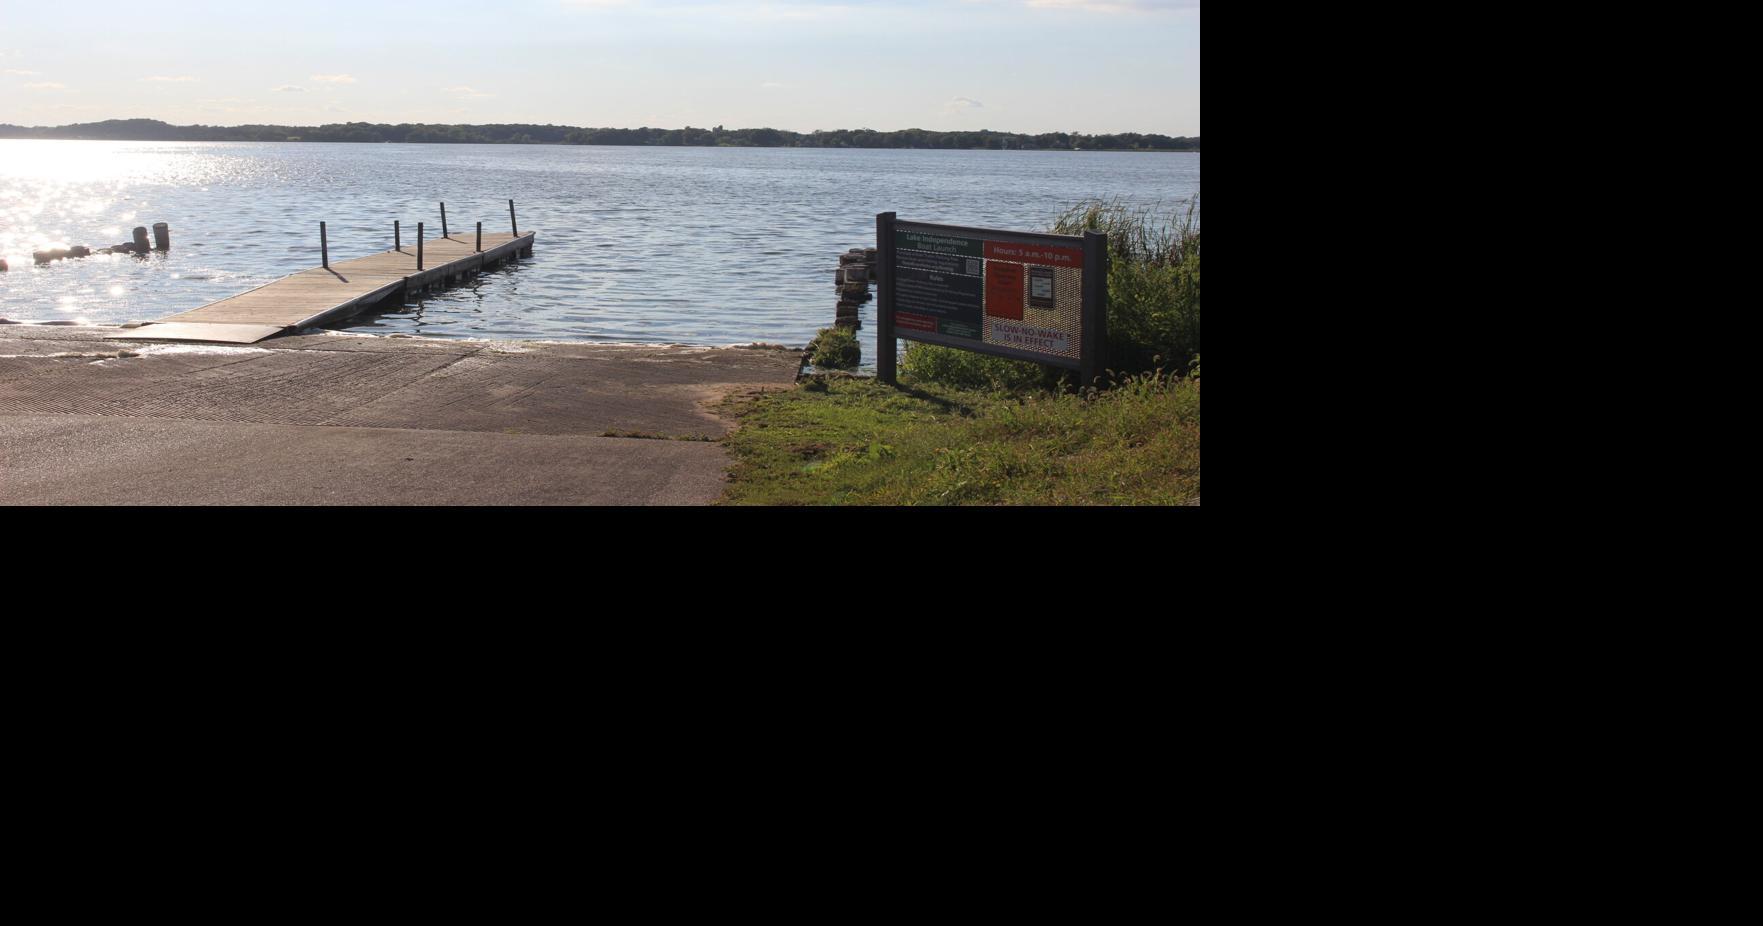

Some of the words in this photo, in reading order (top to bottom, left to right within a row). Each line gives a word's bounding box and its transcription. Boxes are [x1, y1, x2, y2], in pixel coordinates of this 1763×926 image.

[906, 233, 920, 242] Lake
[922, 235, 969, 247] Independence
[993, 246, 1017, 256] Hours:
[1004, 334, 1011, 342] IS
[1013, 335, 1022, 343] IN
[1024, 336, 1054, 348] EFFECT
